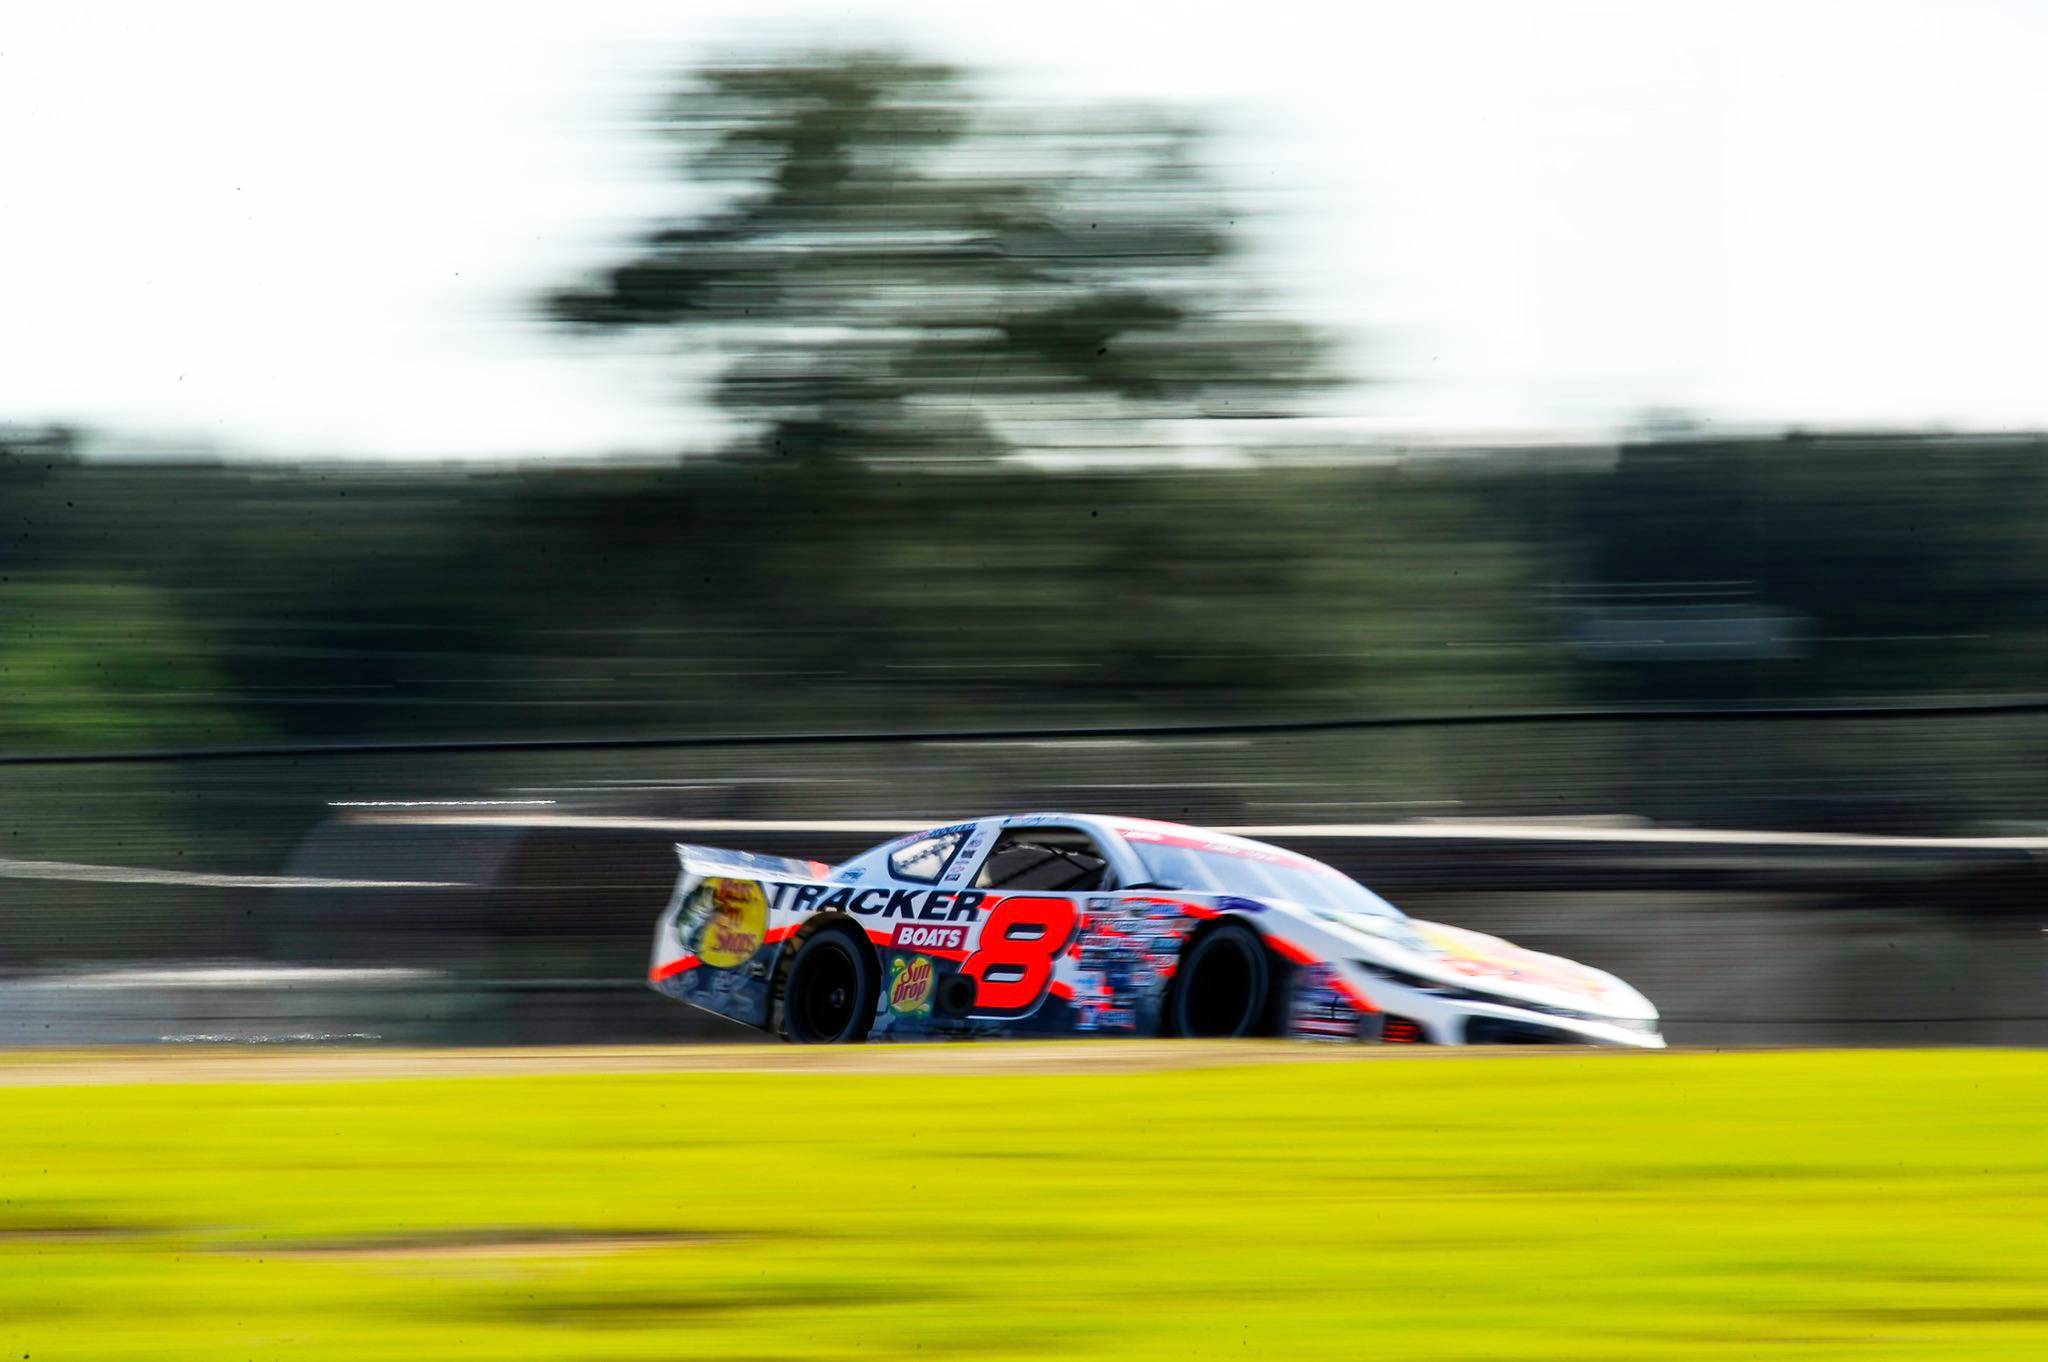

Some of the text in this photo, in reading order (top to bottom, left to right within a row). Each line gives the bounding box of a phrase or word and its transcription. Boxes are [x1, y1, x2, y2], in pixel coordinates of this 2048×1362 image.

[771, 882, 987, 922] TRACKER
[898, 927, 961, 948] BOATS
[960, 897, 1081, 1010] 8
[900, 959, 931, 984] Sun
